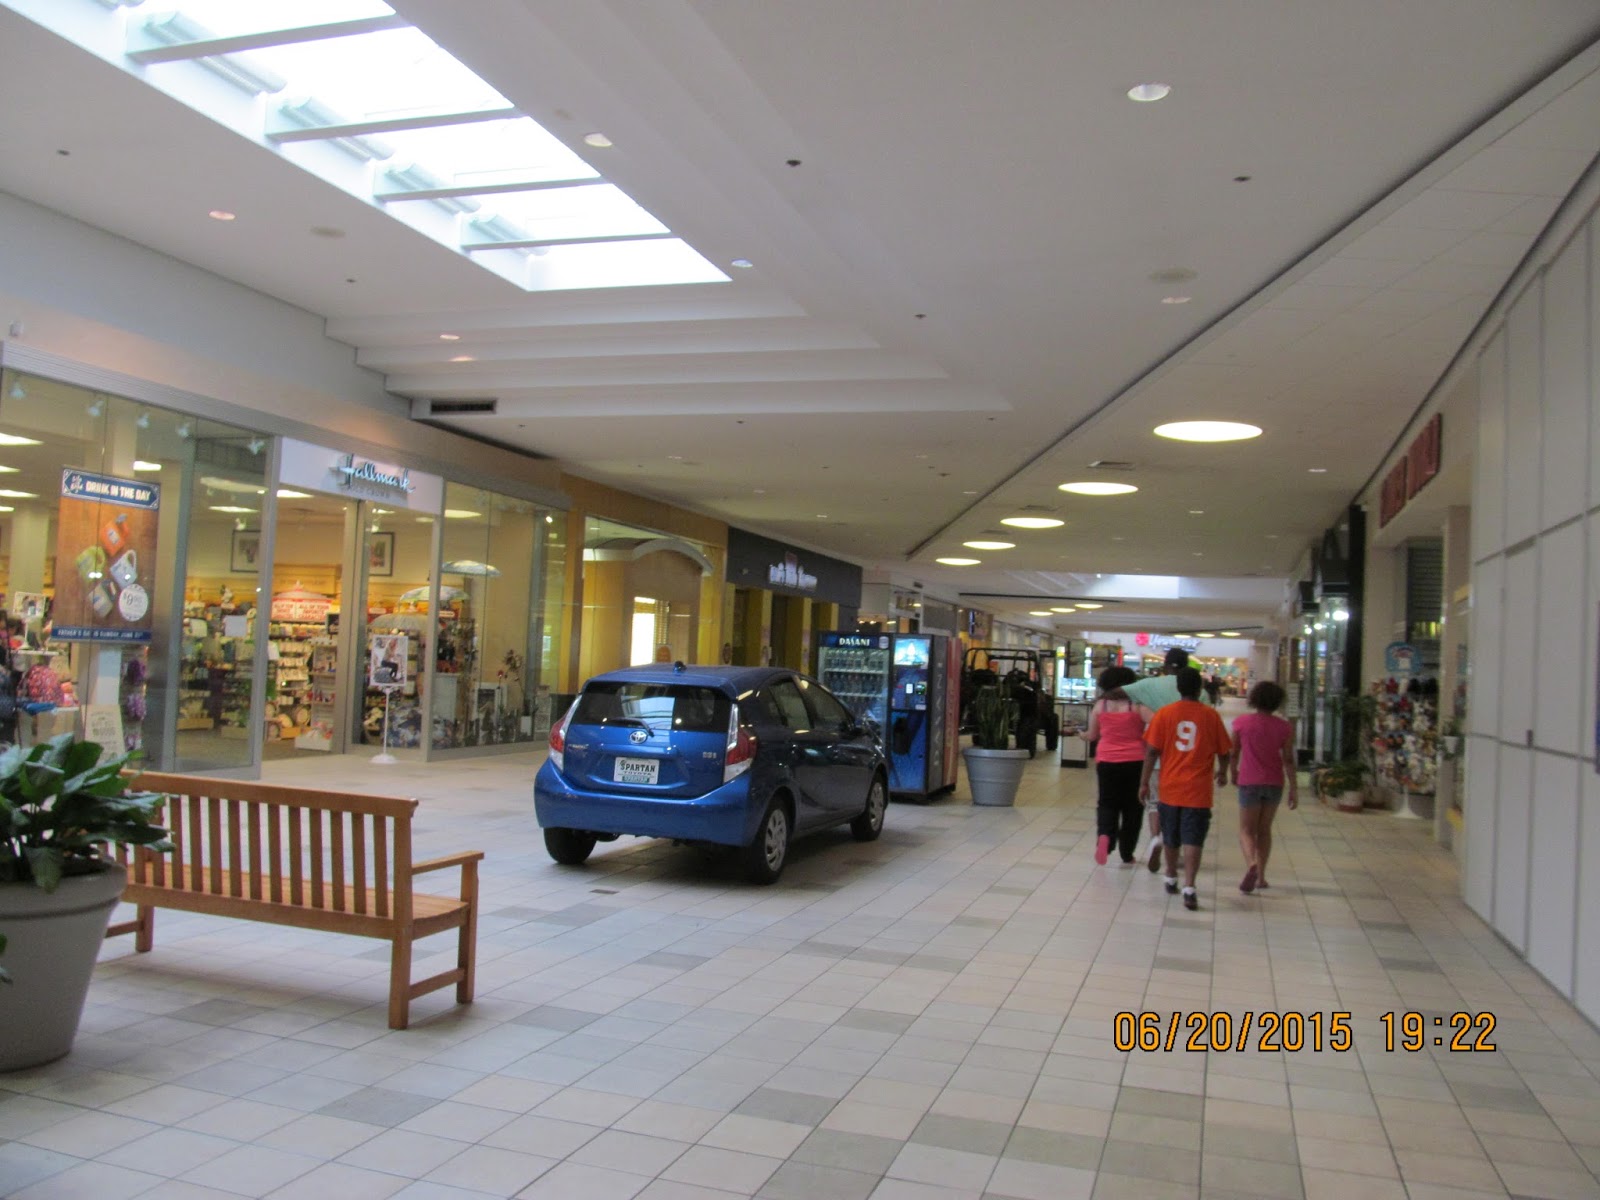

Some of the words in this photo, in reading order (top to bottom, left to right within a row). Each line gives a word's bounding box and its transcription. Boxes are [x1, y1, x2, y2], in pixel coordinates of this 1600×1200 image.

[337, 453, 416, 493] Hallmark
[85, 480, 110, 495] DRINK
[119, 486, 135, 499] THE
[135, 488, 151, 502] DAY
[838, 637, 870, 647] DASANI
[1176, 720, 1197, 752] 9
[620, 760, 656, 773] SPARTAN
